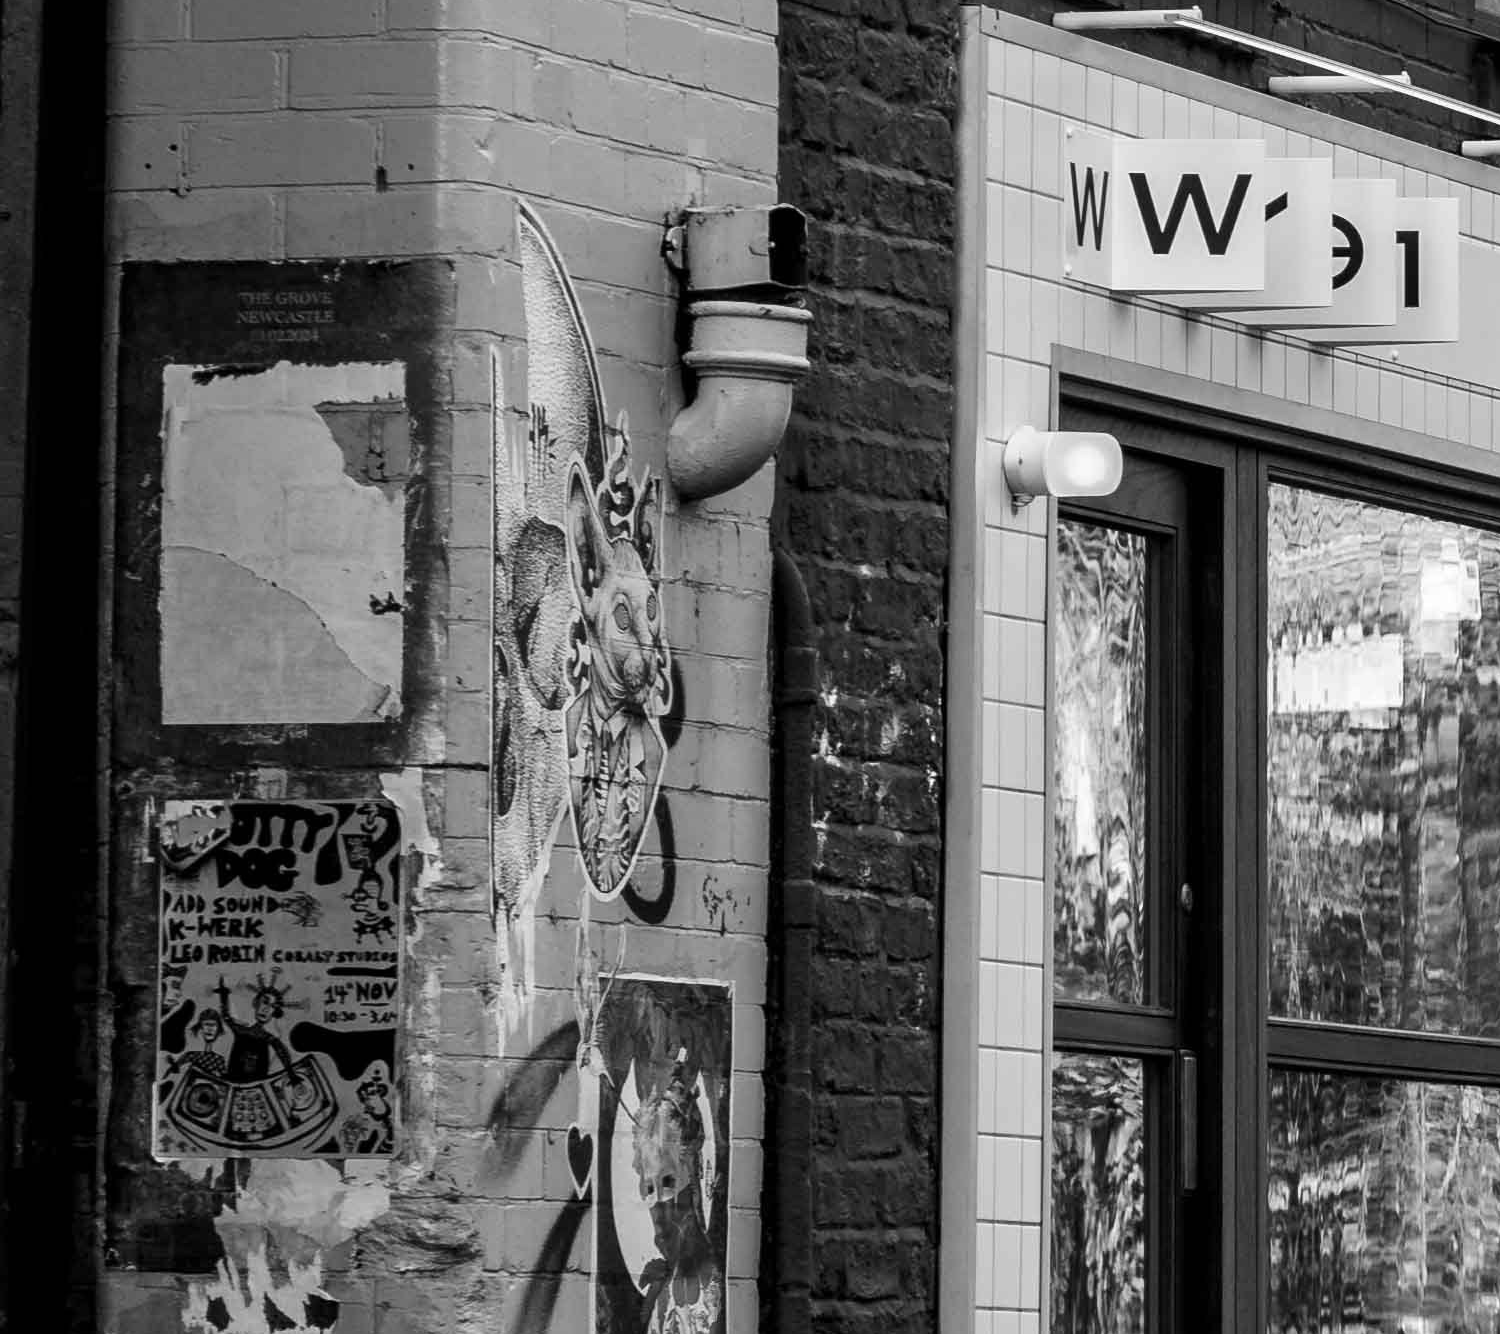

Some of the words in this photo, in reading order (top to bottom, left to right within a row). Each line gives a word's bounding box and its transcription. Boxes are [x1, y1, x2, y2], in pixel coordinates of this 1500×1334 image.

[238, 291, 273, 305] THE
[275, 291, 335, 306] GROVE
[235, 309, 337, 324] NEWCASTLE
[216, 847, 300, 892] DOG
[212, 895, 279, 914] SOUND
[168, 915, 264, 941] K-WERK
[170, 944, 204, 963] LEO
[207, 944, 265, 965] ROBIN
[355, 981, 398, 1002] NOV
